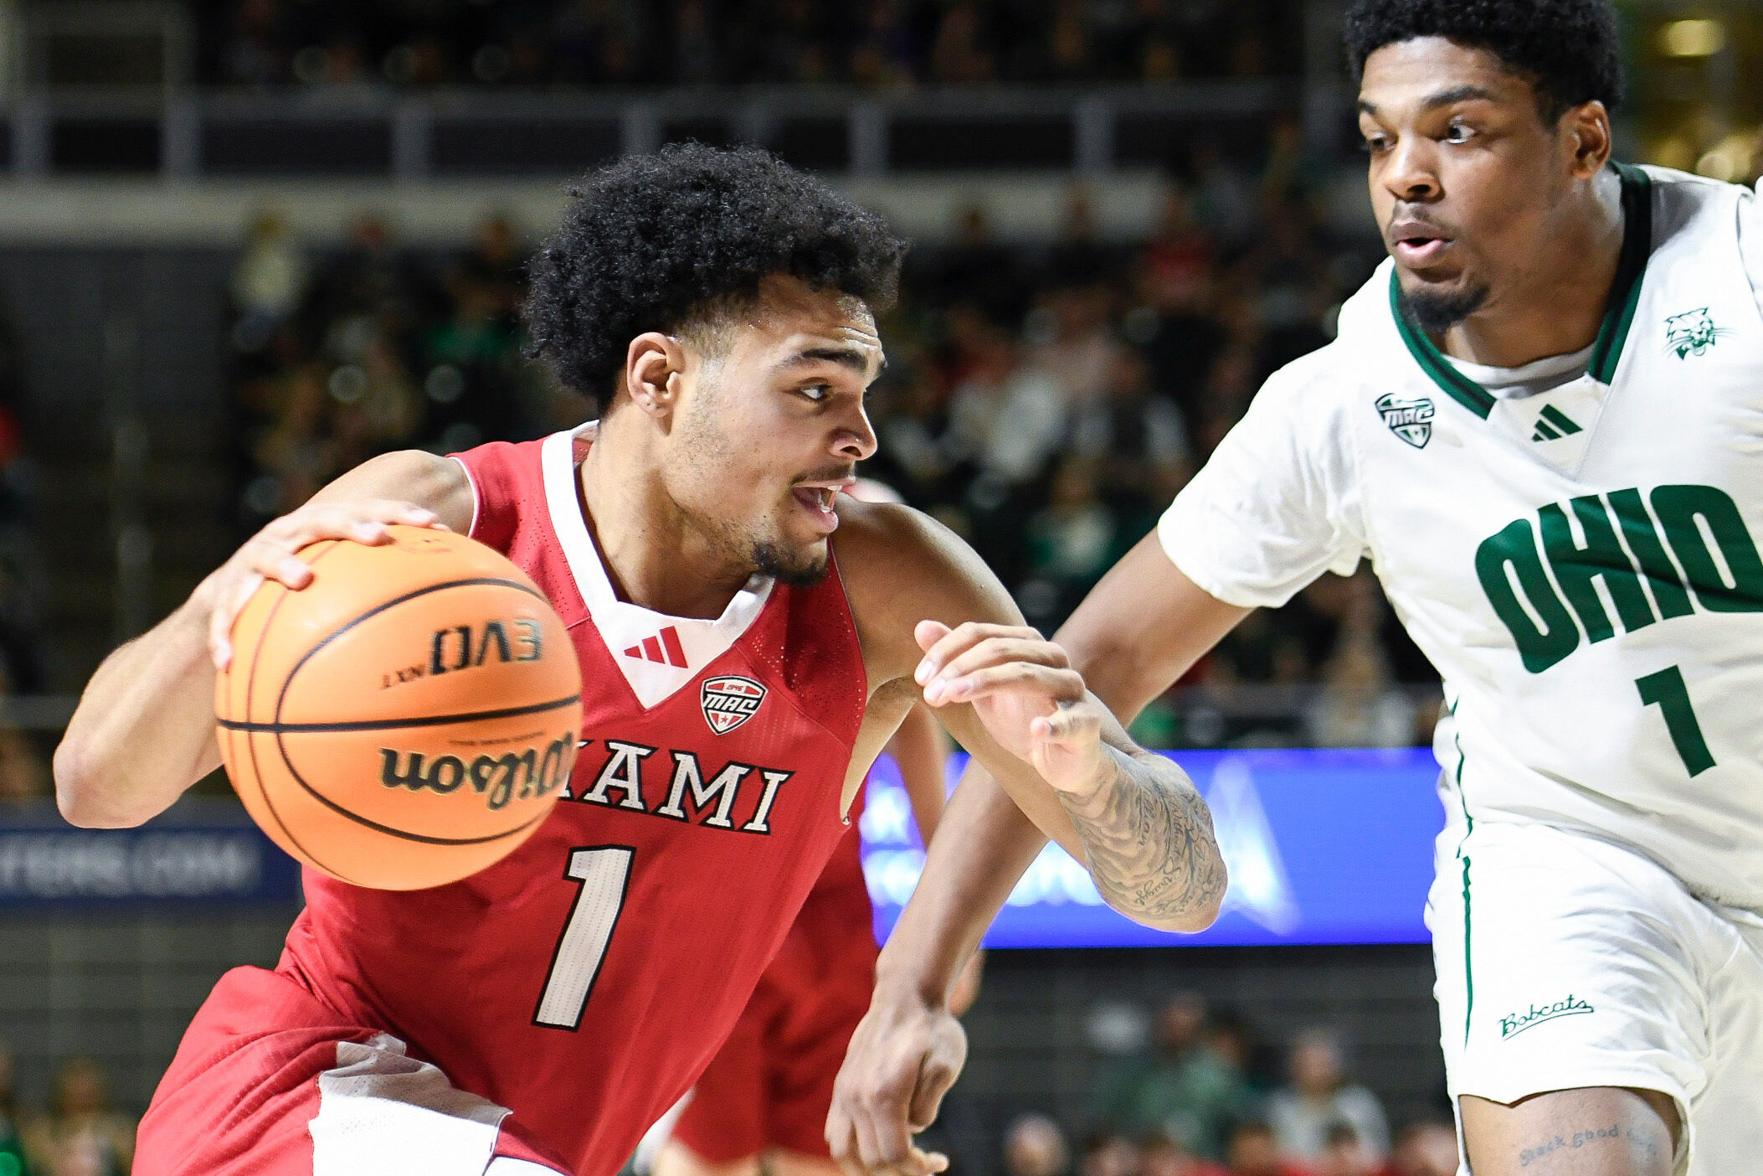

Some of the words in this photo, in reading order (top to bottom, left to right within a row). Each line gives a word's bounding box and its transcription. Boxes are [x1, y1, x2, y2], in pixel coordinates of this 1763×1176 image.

[1383, 407, 1435, 427] MAC
[1475, 484, 1763, 674] OHIO
[381, 664, 428, 690] NXT
[430, 617, 543, 676] EVO
[702, 693, 759, 713] MAC
[1634, 664, 1718, 779] 1
[378, 732, 574, 811] Wilson
[559, 739, 796, 836] AMI
[531, 844, 637, 1032] 1
[1498, 994, 1595, 1040] Bobcats
